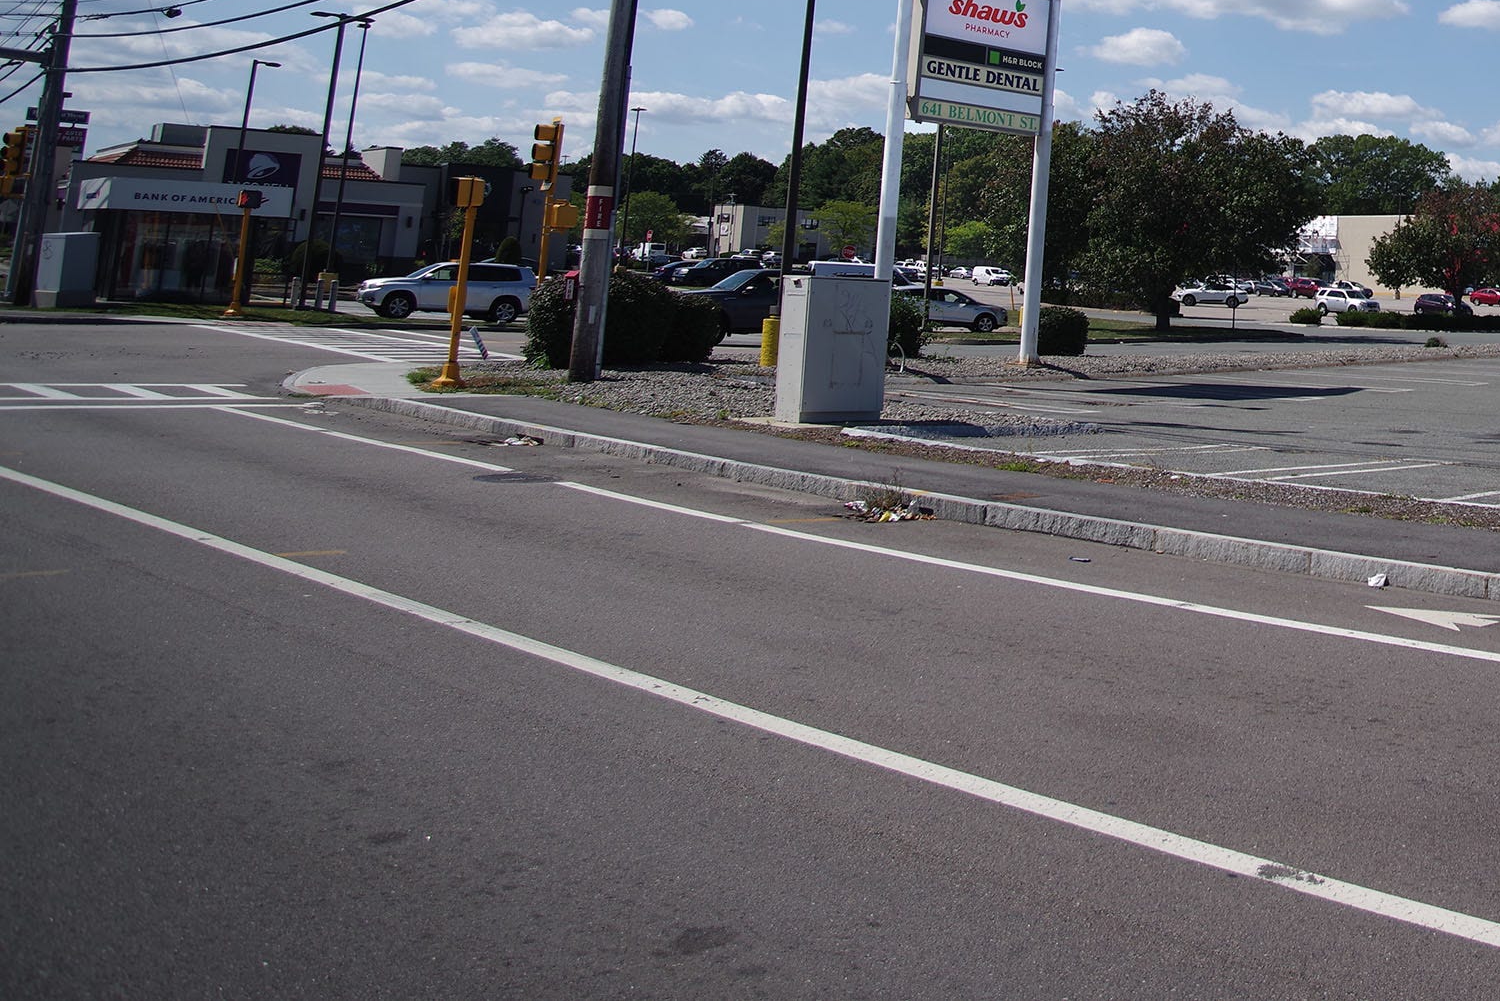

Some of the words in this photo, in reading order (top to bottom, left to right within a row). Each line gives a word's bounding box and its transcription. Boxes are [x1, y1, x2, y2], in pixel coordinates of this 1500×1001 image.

[965, 23, 1011, 39] PHARMACY
[1002, 55, 1018, 66] H&R
[1019, 58, 1043, 69] BLOCK
[926, 60, 980, 82] GENTLE
[985, 70, 1040, 92] DENTAL
[921, 103, 943, 117] 641
[948, 105, 1014, 126] BELMONT
[1019, 116, 1037, 130] ST.
[134, 192, 168, 201] BANK
[171, 194, 187, 202] OF
[190, 195, 238, 205] AMERIC
[596, 198, 604, 227] FIRE
